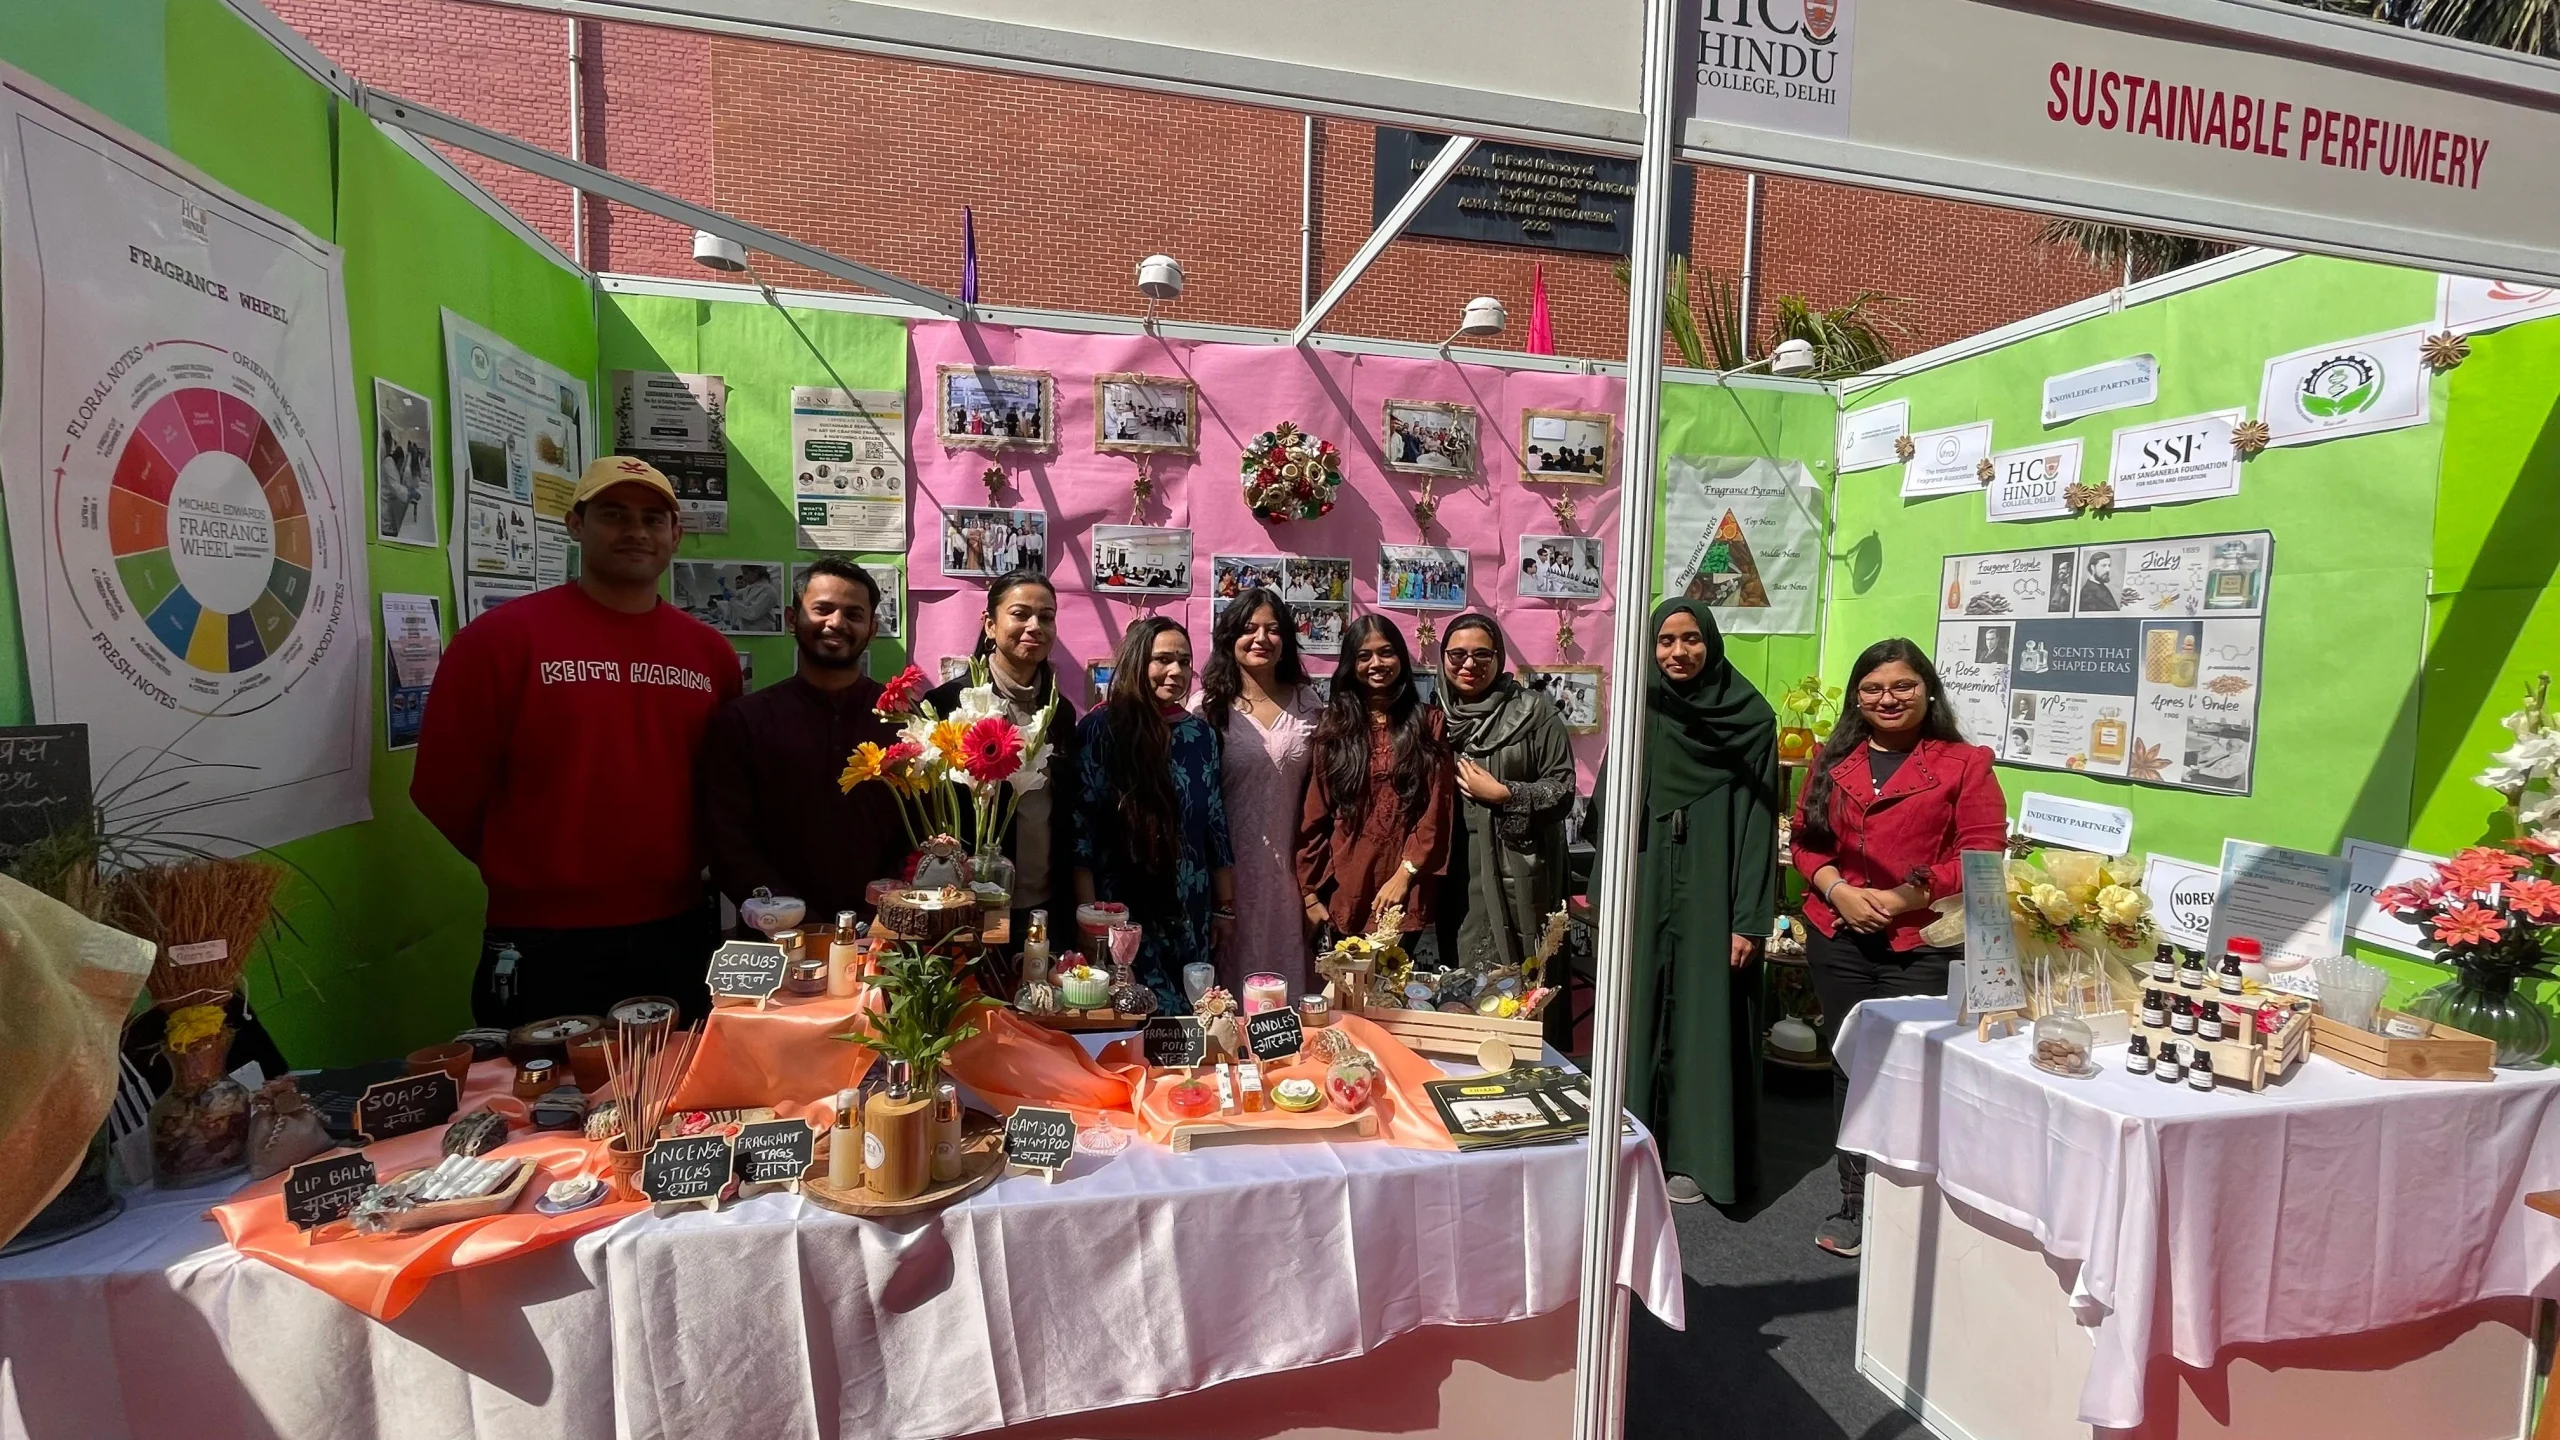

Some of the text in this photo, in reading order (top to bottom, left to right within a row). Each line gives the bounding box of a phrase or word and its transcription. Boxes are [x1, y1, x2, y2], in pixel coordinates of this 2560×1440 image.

[1696, 30, 1838, 83] HINDU
[1696, 69, 1836, 105] COLLEGE, DELHI
[2047, 61, 2489, 190] SUSTAINABLE PERFUMERY
[1411, 158, 1430, 171] KA
[1559, 177, 1584, 189] ROY
[1491, 153, 1503, 165] In
[1506, 154, 1533, 168] Fond
[1582, 164, 1595, 175] of
[1457, 196, 1488, 211] ASHA
[1505, 200, 1536, 214] SANT
[1543, 190, 1577, 204] Gifted
[1522, 220, 1551, 232] 2020
[128, 245, 288, 325] FRAGRANCE WHEEL
[66, 380, 113, 440] FLORAL
[106, 346, 143, 386] NOTES
[232, 351, 281, 400] ORIENTAL
[279, 395, 306, 438] NOTES
[2049, 375, 2150, 404] KNOWLEDGE PARTNERS
[2140, 431, 2210, 470] SSF
[1916, 472, 1974, 486] Fragrance Association
[1925, 464, 1968, 476] The International
[2006, 458, 2044, 485] HC
[2119, 461, 2228, 482] SANT SANGANERIA FOUNDATION
[2146, 478, 2164, 486] HEALTH
[2177, 473, 2207, 482] EDUCATION
[1704, 485, 1786, 499] Fragrance Pyramid
[2003, 481, 2057, 501] HINDU
[178, 498, 266, 521] MICHAEL EDWARDS
[2002, 496, 2056, 508] COLLEGE, DELHI
[179, 517, 269, 543] FRAGRANCE
[1744, 517, 1776, 528] Top Notes
[180, 537, 233, 559] WHEEL
[1675, 516, 1718, 589] Fragrance notes
[1760, 550, 1800, 558] Middle Notes
[1977, 559, 2010, 575] Fougere
[2141, 549, 2182, 570] Jicky
[308, 624, 336, 667] WOODY
[329, 582, 345, 625] NOTES
[2052, 647, 2132, 659] SCENTS THAT
[92, 631, 179, 710] FRESH NOTES
[540, 660, 712, 693] KEITH HARING
[1938, 660, 1980, 678] La Rose
[2052, 660, 2131, 673] SHAPED ERAS
[2151, 694, 2184, 711] Apres
[2202, 692, 2240, 712] Ondee
[2027, 810, 2123, 835] INDUSTRY PARTNERS
[2175, 892, 2215, 905] NOREX
[2183, 912, 2210, 934] 32
[718, 953, 780, 969] SCRUBS
[1145, 1026, 1205, 1040] FRAGRANCE
[1250, 1015, 1295, 1036] CANDLES
[1162, 1041, 1196, 1051] POTLIS
[366, 1082, 438, 1112] SOAPS
[1010, 1118, 1067, 1137] BAMBOO
[738, 1131, 803, 1150] FRAGRANT
[1010, 1136, 1071, 1150] SHAMPOO
[652, 1141, 726, 1165] INCENSE
[755, 1148, 795, 1161] TAGS
[294, 1163, 375, 1194] LIP BALM
[658, 1163, 711, 1188] STICKS
